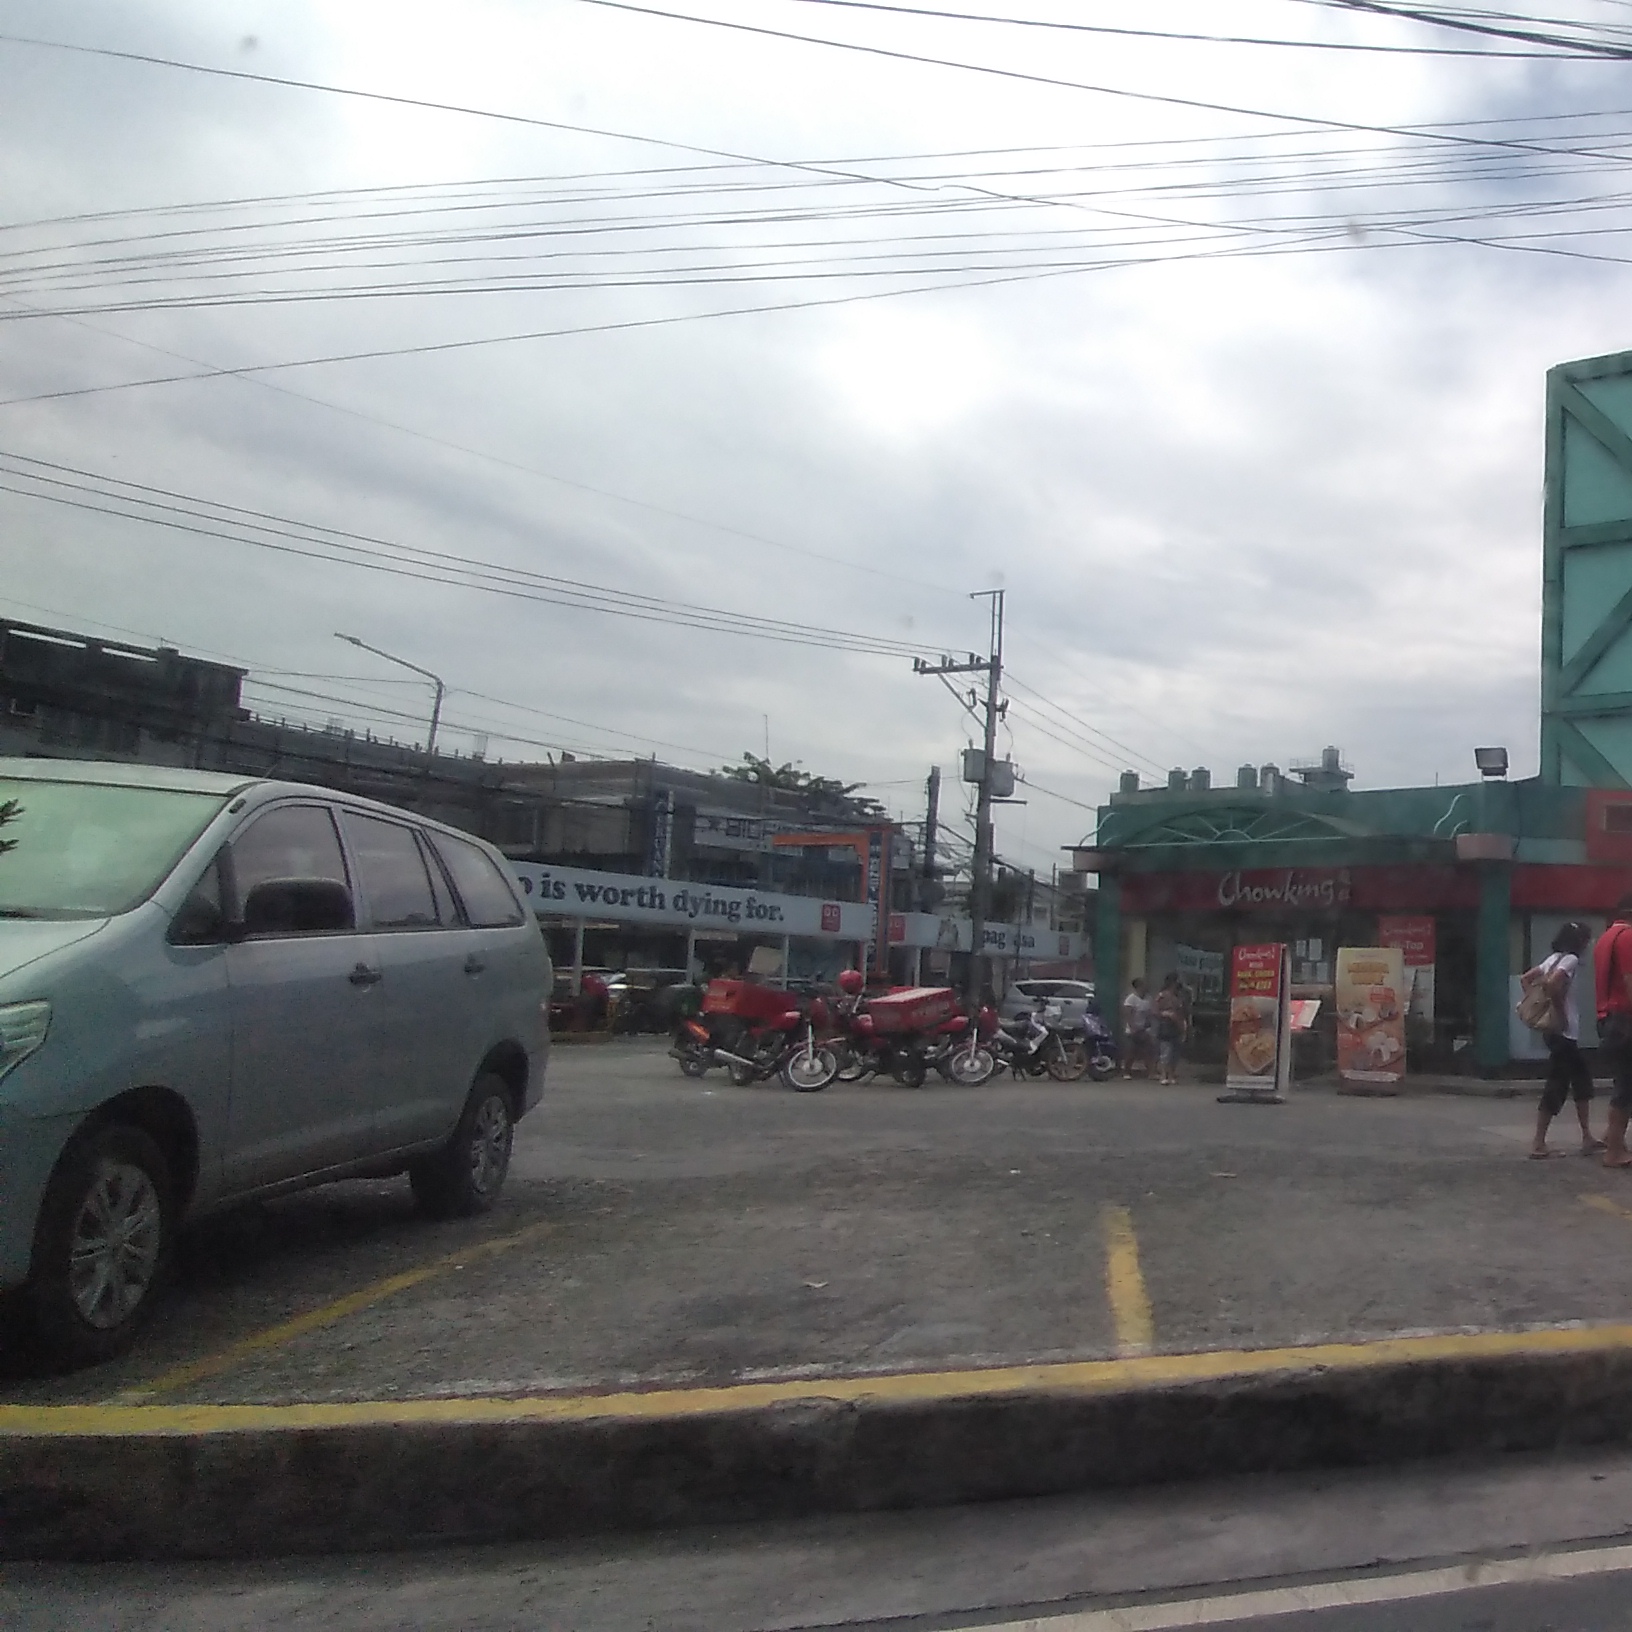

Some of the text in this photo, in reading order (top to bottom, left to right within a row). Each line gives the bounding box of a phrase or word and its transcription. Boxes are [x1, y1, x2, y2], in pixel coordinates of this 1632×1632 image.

[540, 873, 566, 900] is
[574, 883, 666, 910] worth
[672, 889, 742, 922] dying
[745, 897, 785, 922] for.
[1219, 871, 1334, 906] Chowking
